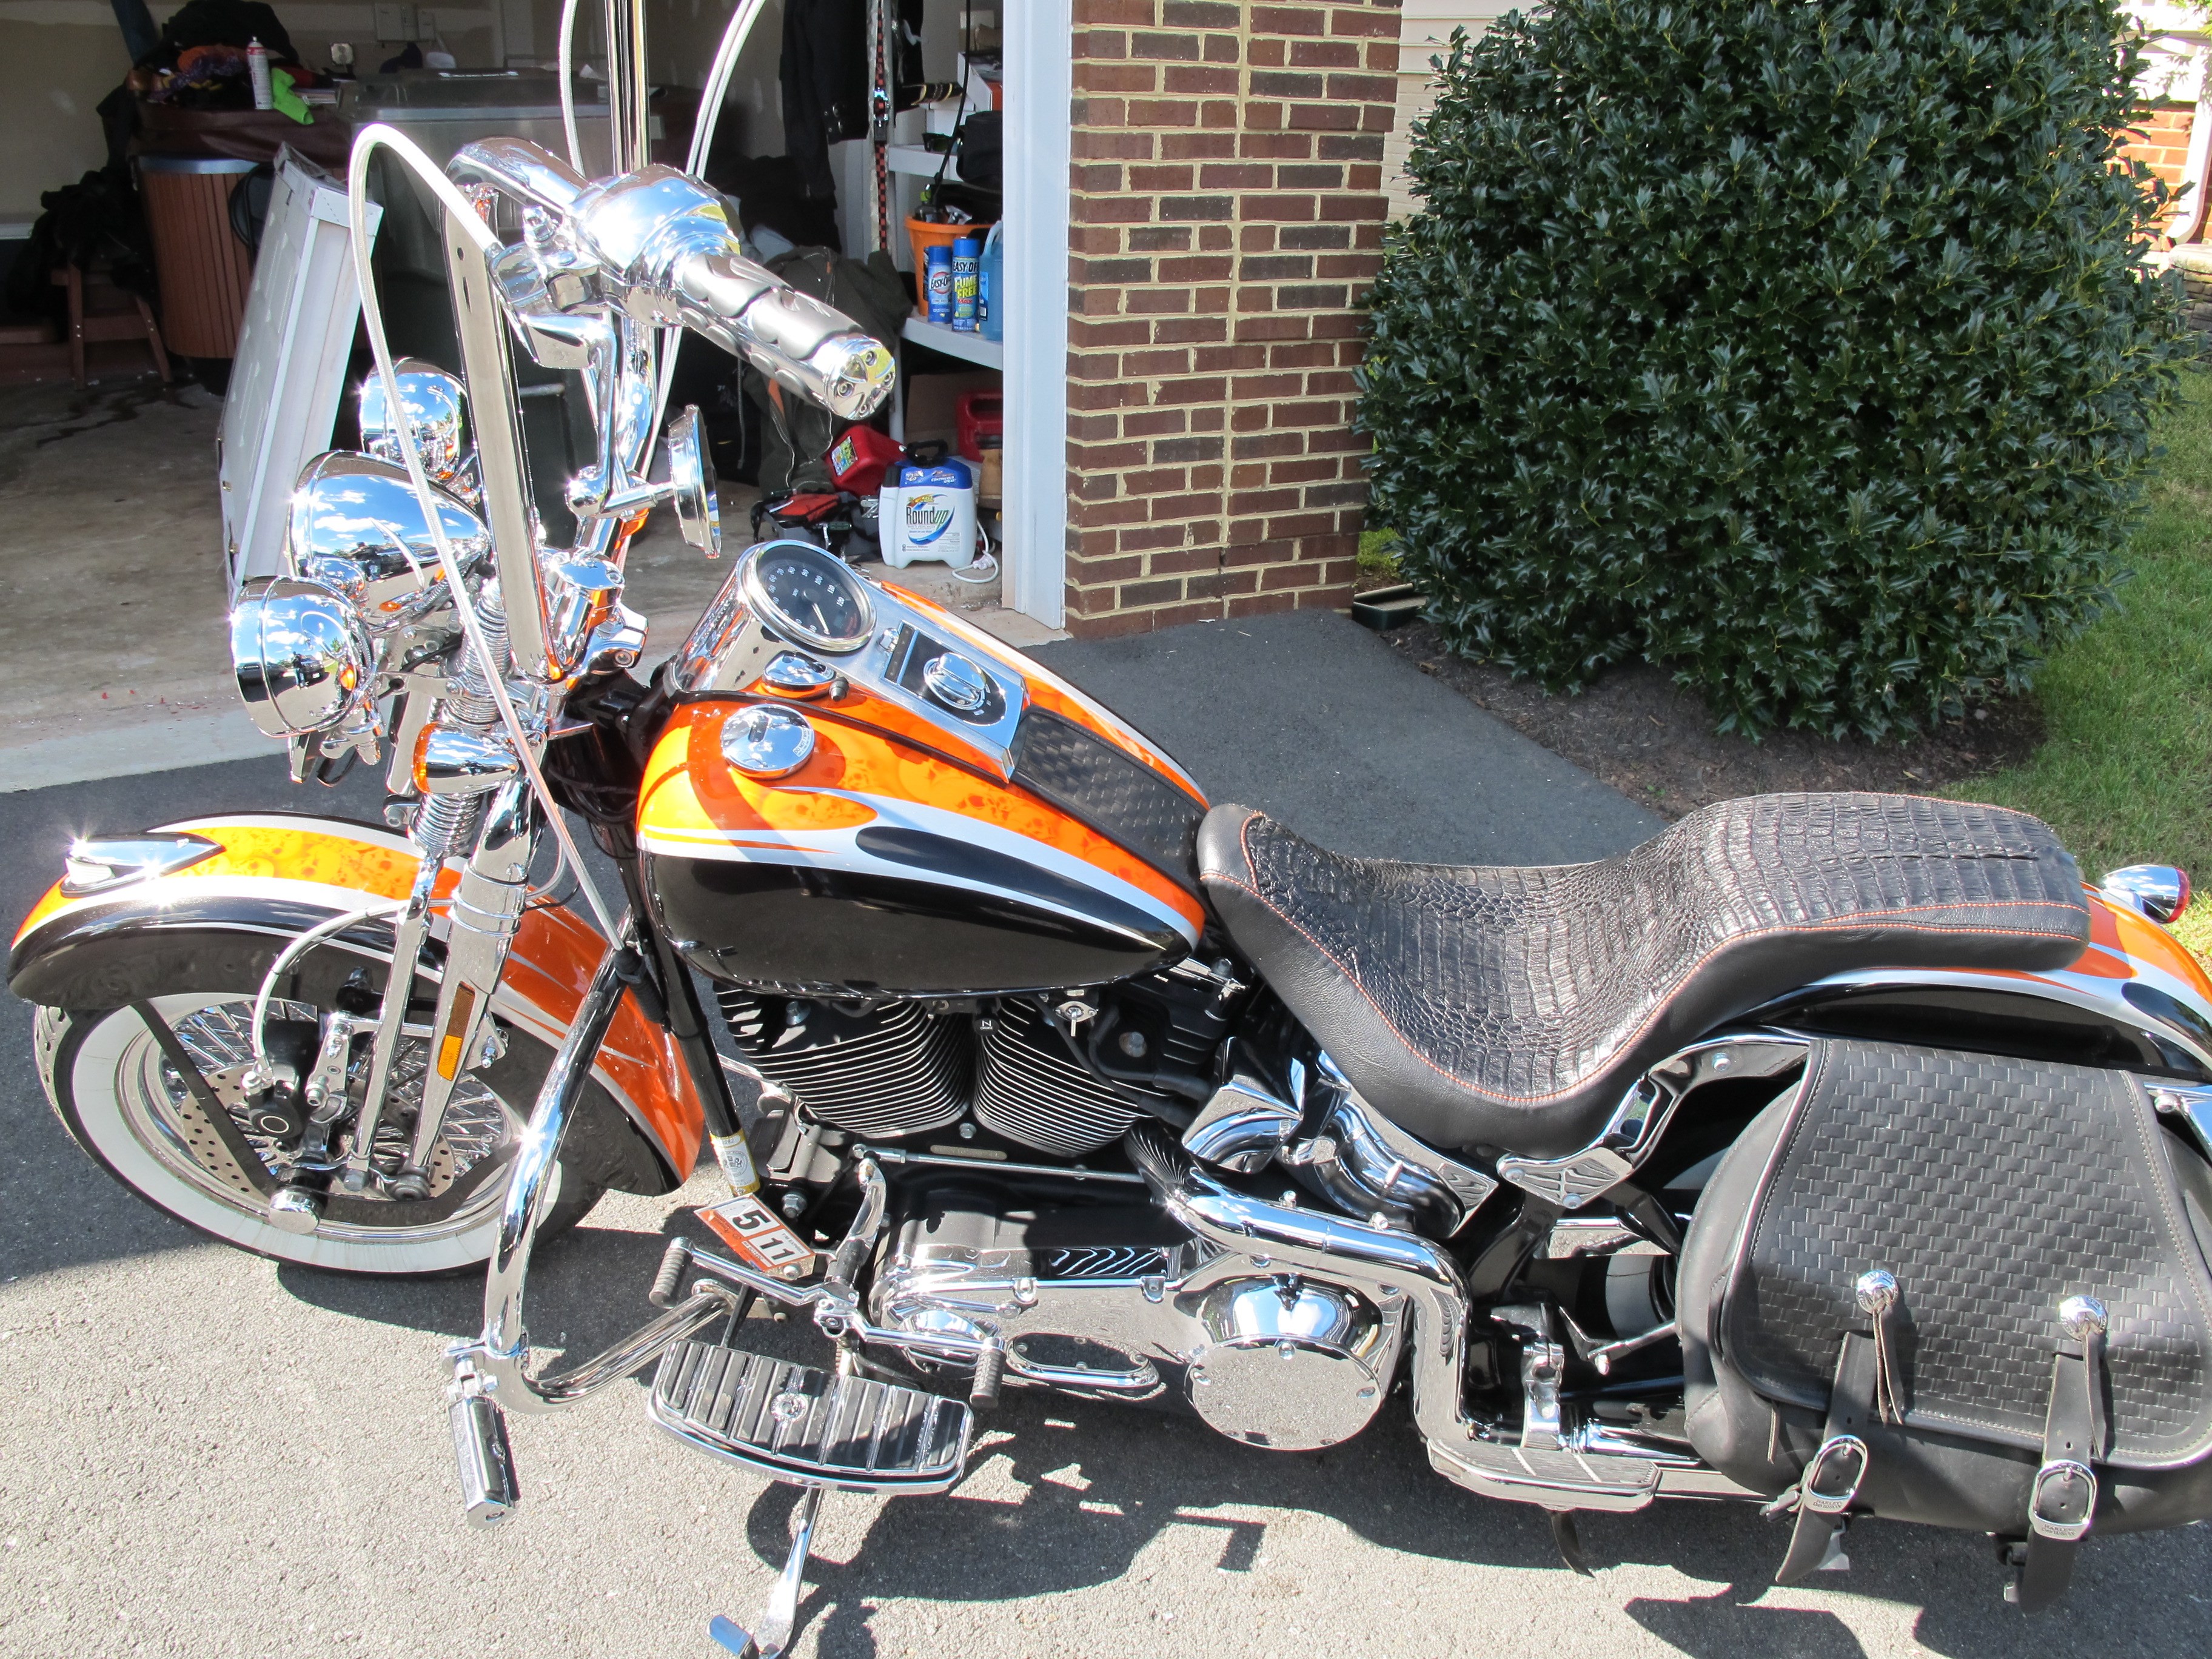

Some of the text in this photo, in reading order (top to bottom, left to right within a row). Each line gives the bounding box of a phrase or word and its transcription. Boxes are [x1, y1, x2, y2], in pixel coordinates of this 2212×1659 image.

[954, 274, 977, 292] FUME
[957, 285, 977, 299] FREE
[906, 506, 950, 531] Roundup
[827, 585, 836, 594] 110
[836, 596, 845, 607] 120
[732, 1209, 771, 1230] 5
[759, 1237, 796, 1261] 11
